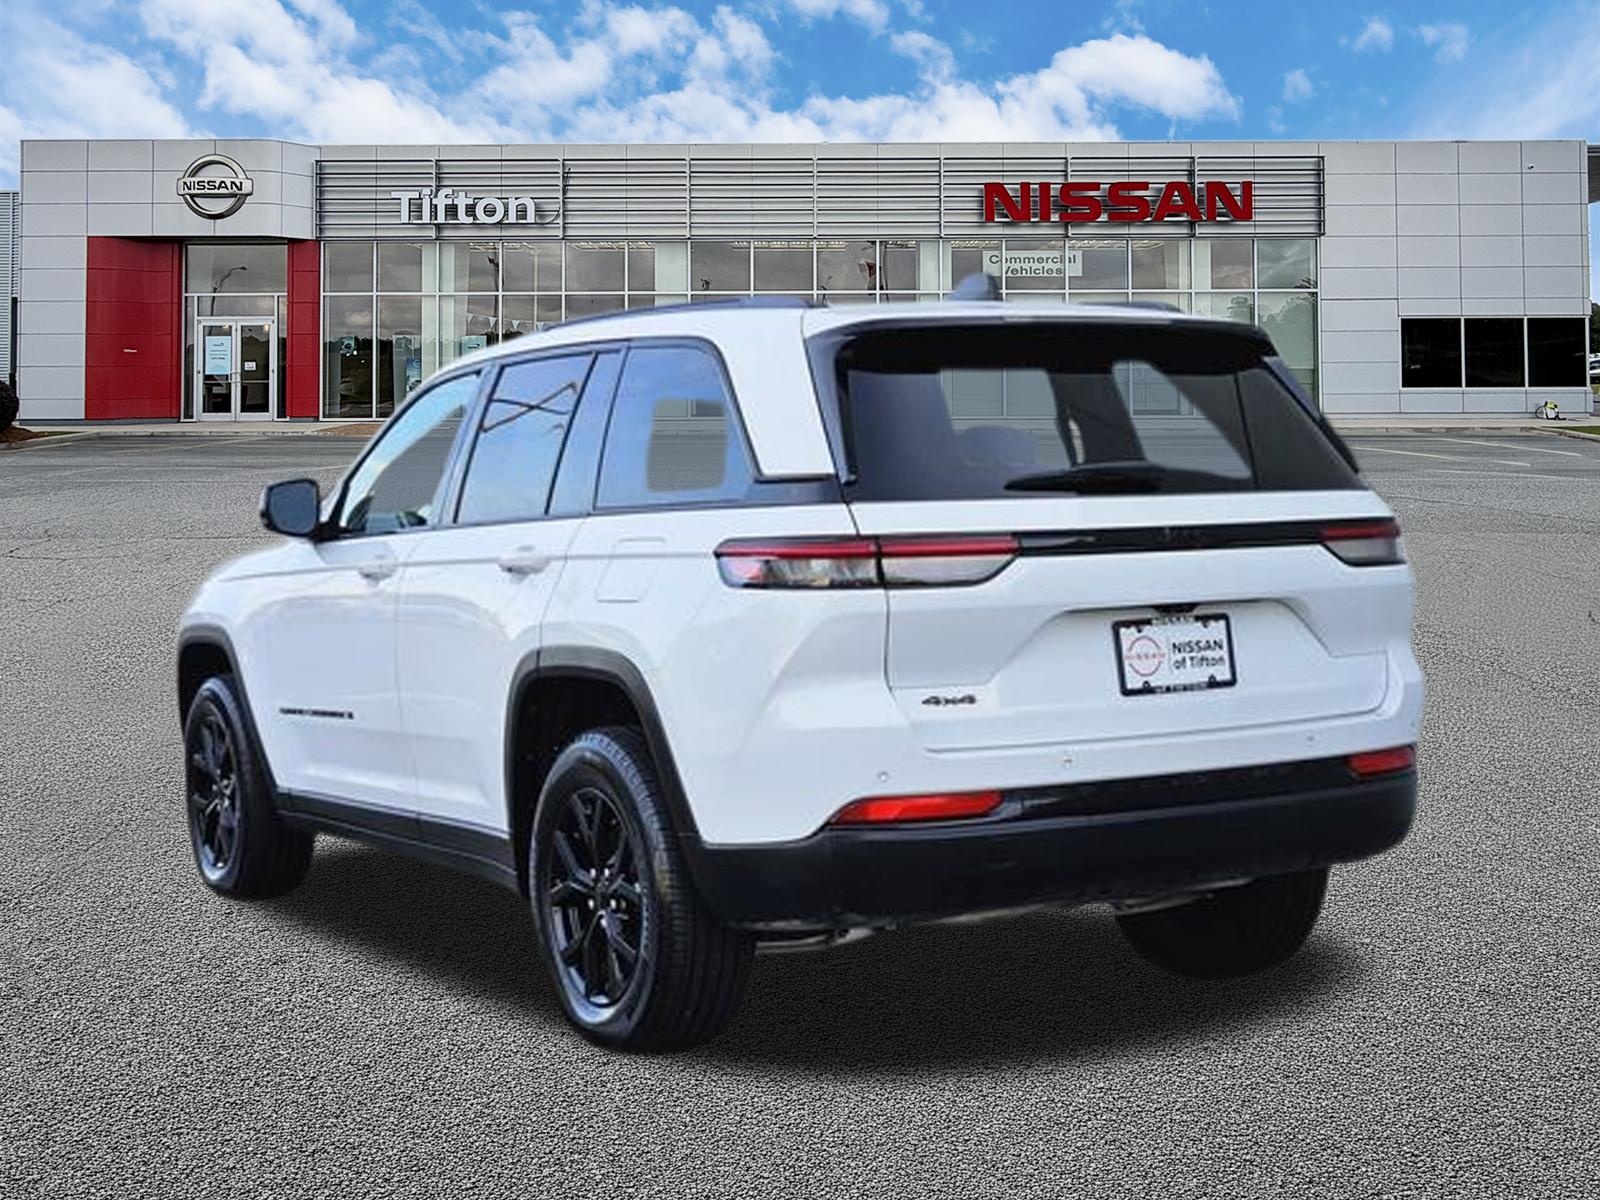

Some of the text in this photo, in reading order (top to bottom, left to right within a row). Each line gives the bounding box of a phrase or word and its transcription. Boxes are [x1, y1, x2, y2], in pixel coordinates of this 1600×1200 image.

[182, 180, 243, 191] NISSAN
[391, 187, 536, 225] Tifton
[983, 180, 1254, 223] NISSAN
[1171, 639, 1224, 654] NISSAN
[1172, 655, 1225, 669] of Tifton
